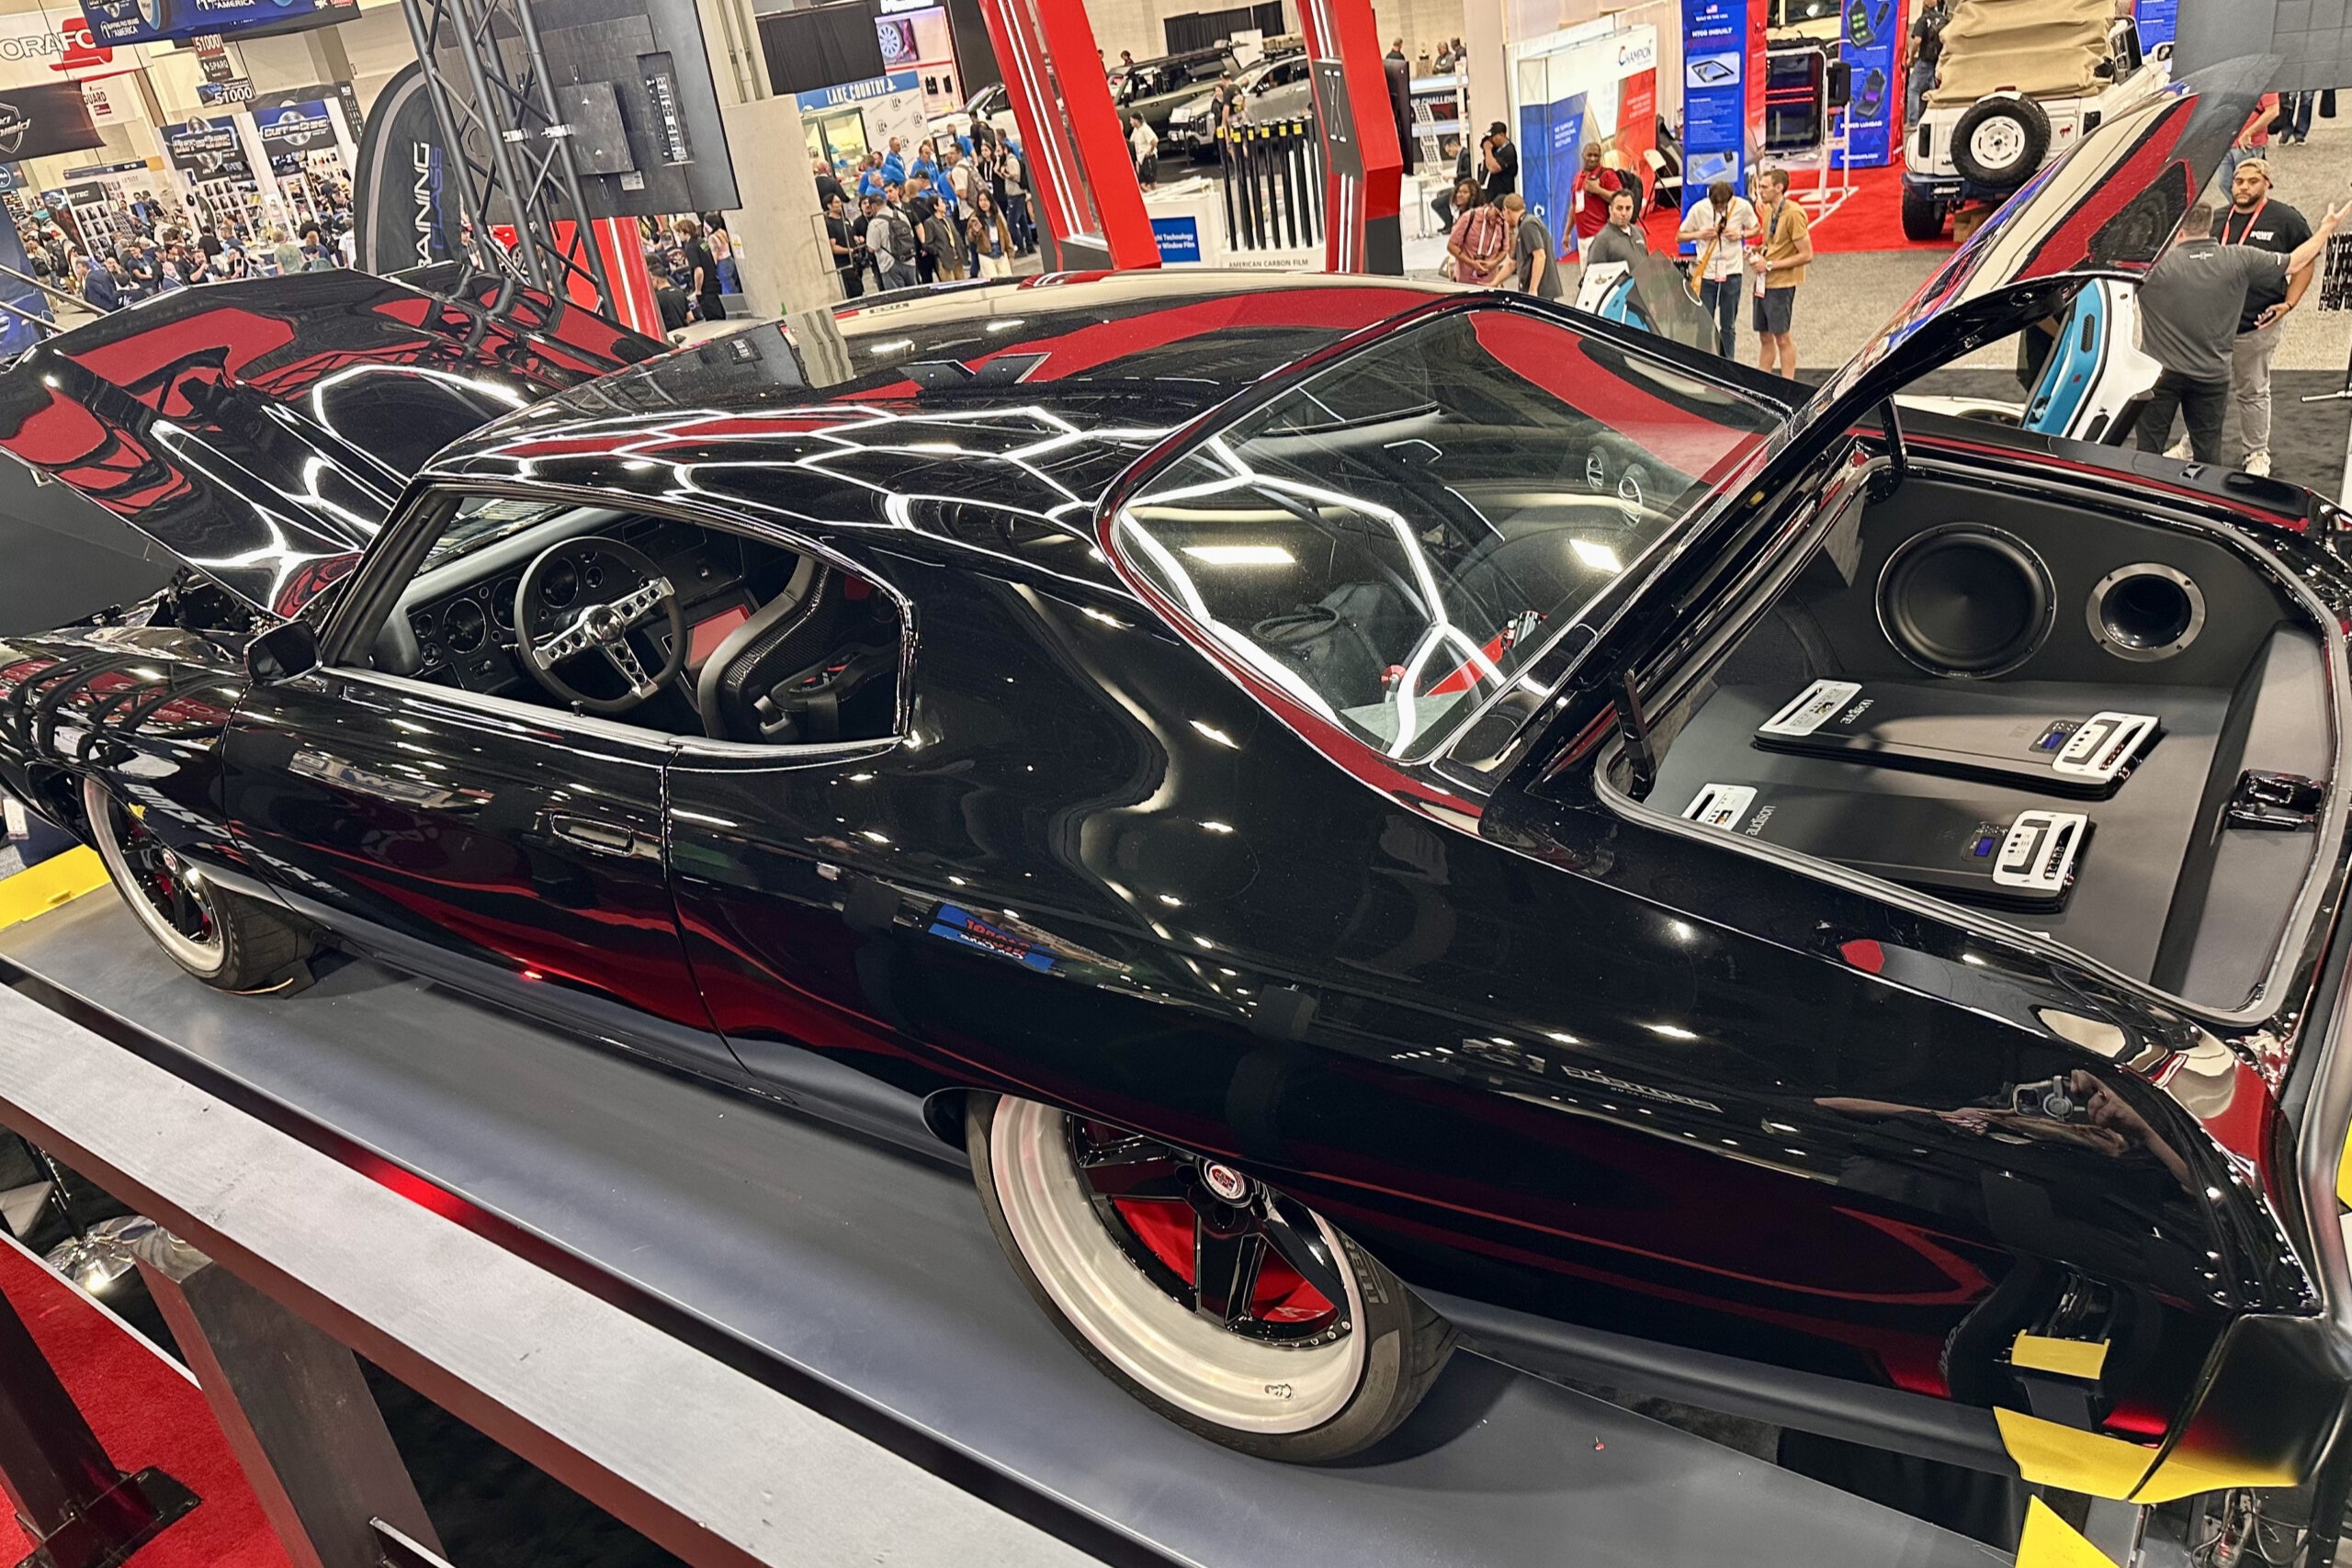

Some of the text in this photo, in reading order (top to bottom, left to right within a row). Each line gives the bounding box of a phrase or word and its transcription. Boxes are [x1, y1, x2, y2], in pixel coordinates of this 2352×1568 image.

[194, 33, 221, 52] 51000
[214, 87, 253, 105] 51000
[826, 79, 887, 105] LAKE COUNTRY
[1162, 233, 1194, 243] Technology
[1263, 259, 1292, 267] CARBON
[1293, 258, 1308, 266] FILM
[1746, 806, 1776, 836] audison
